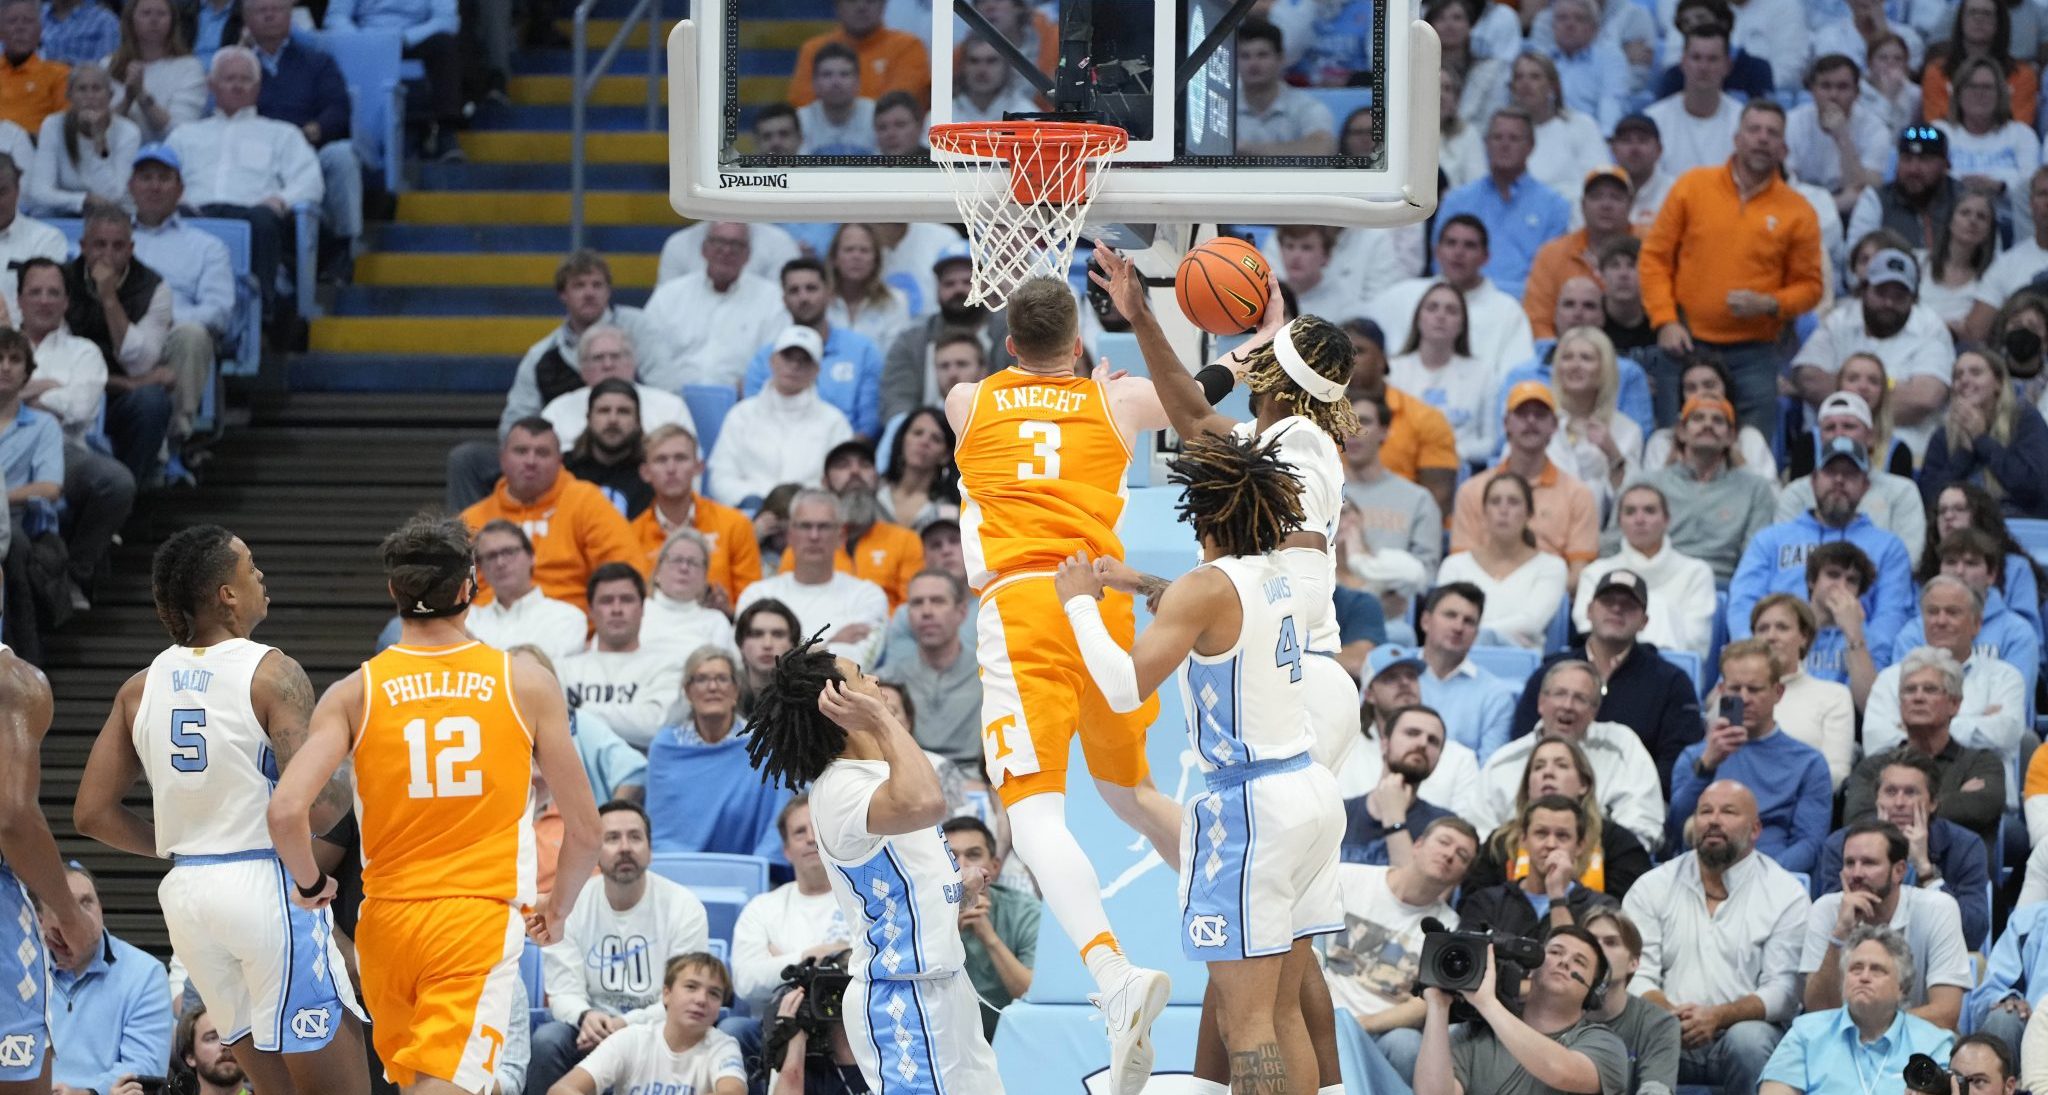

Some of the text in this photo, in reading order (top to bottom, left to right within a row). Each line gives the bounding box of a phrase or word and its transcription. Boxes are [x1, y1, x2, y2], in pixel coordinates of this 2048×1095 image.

[719, 173, 788, 189] SPALDING
[993, 386, 1087, 412] KNECHT
[1017, 420, 1061, 480] 3
[1263, 576, 1291, 605] DAVIS
[1275, 615, 1302, 684] 4
[172, 669, 214, 694] BACOT
[382, 671, 496, 707] PHILLIPS
[170, 708, 208, 772] 5
[403, 715, 482, 798] 12
